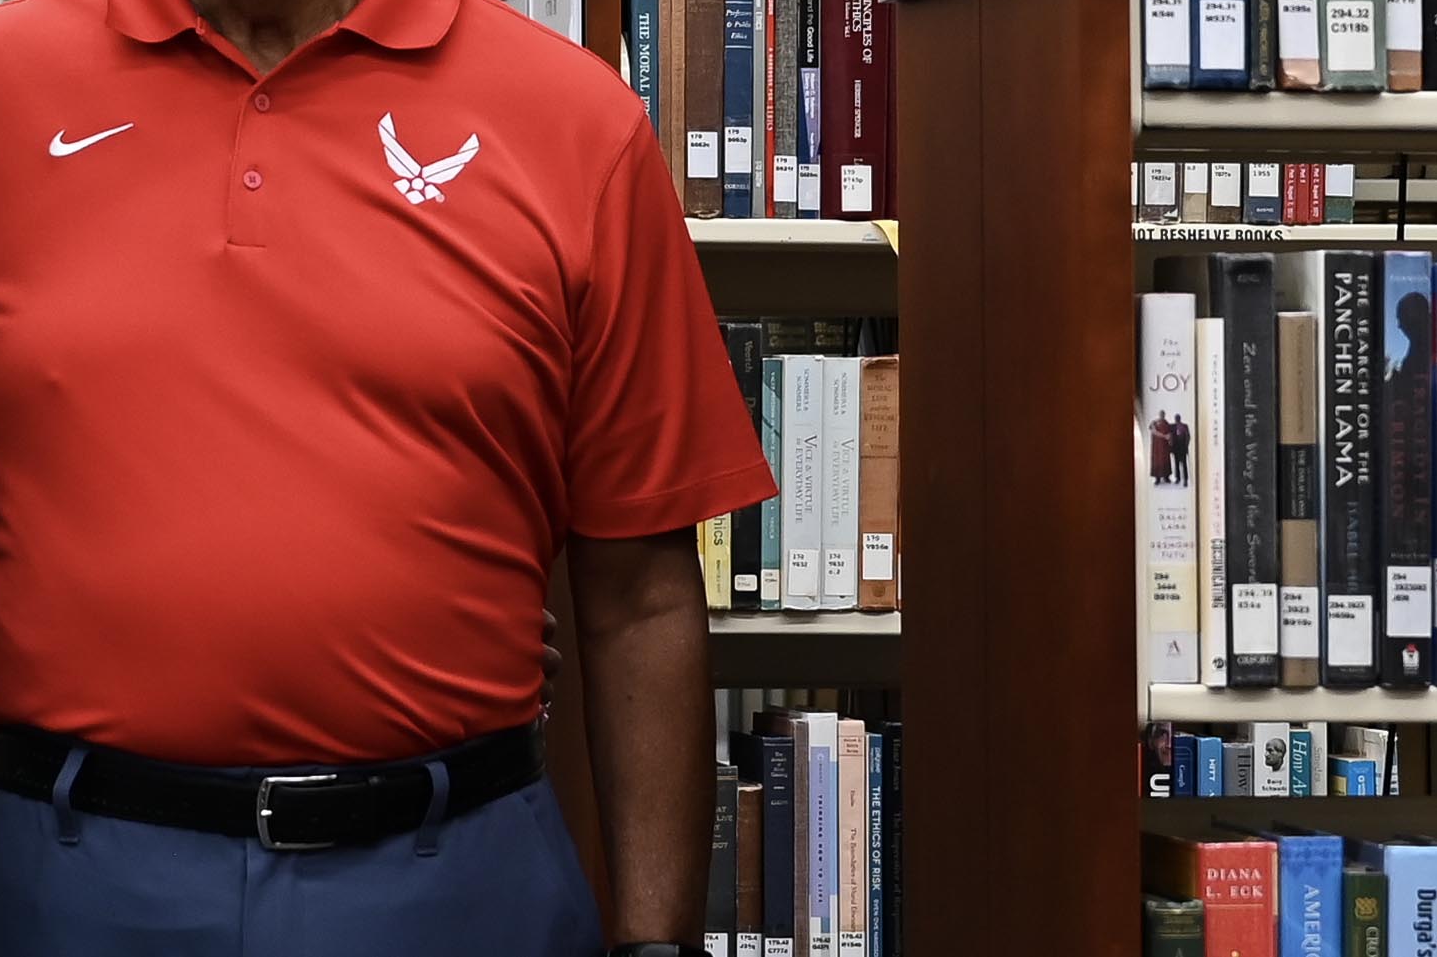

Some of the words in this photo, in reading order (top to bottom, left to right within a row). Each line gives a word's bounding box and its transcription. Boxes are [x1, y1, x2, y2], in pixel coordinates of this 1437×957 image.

[638, 12, 650, 40] THE
[806, 13, 814, 26] the
[1330, 8, 1370, 19] 294.32
[1330, 22, 1369, 33] C518b
[806, 26, 815, 48] Good
[638, 43, 651, 92] MORAL
[806, 48, 815, 64] Life
[862, 48, 873, 65] OF
[1160, 228, 1231, 242] RESHELVE
[1235, 229, 1284, 242] BOOKS
[1356, 273, 1370, 308] THE
[1333, 271, 1354, 395] PANCHEN
[1243, 341, 1257, 374] Zen
[1356, 317, 1370, 395] SEARCH
[1148, 373, 1192, 392] JOY
[1243, 378, 1257, 409] and
[1243, 413, 1258, 437] the
[1356, 403, 1370, 440] FOR
[1333, 404, 1354, 488] LAMA
[795, 447, 804, 501] EVERYDAY
[1242, 442, 1258, 480] Way
[1356, 451, 1370, 485] THE
[832, 451, 841, 504] EVERYDAY
[1243, 482, 1262, 501] of
[804, 475, 813, 514] VIRTUE
[841, 479, 850, 517] VIRTUE
[795, 502, 804, 524] LIFE
[831, 506, 841, 527] LIFE
[1246, 503, 1261, 528] the
[713, 515, 726, 546] hics
[1292, 738, 1308, 774] How
[1238, 753, 1251, 791] How
[871, 785, 881, 808] THE
[871, 809, 881, 849] ETHICS
[871, 850, 881, 865] OF
[871, 867, 881, 891] RISK
[1207, 867, 1262, 881] DIANA
[1205, 885, 1222, 899] L.
[1230, 885, 1264, 899] ECK
[1414, 888, 1437, 957] Durga's
